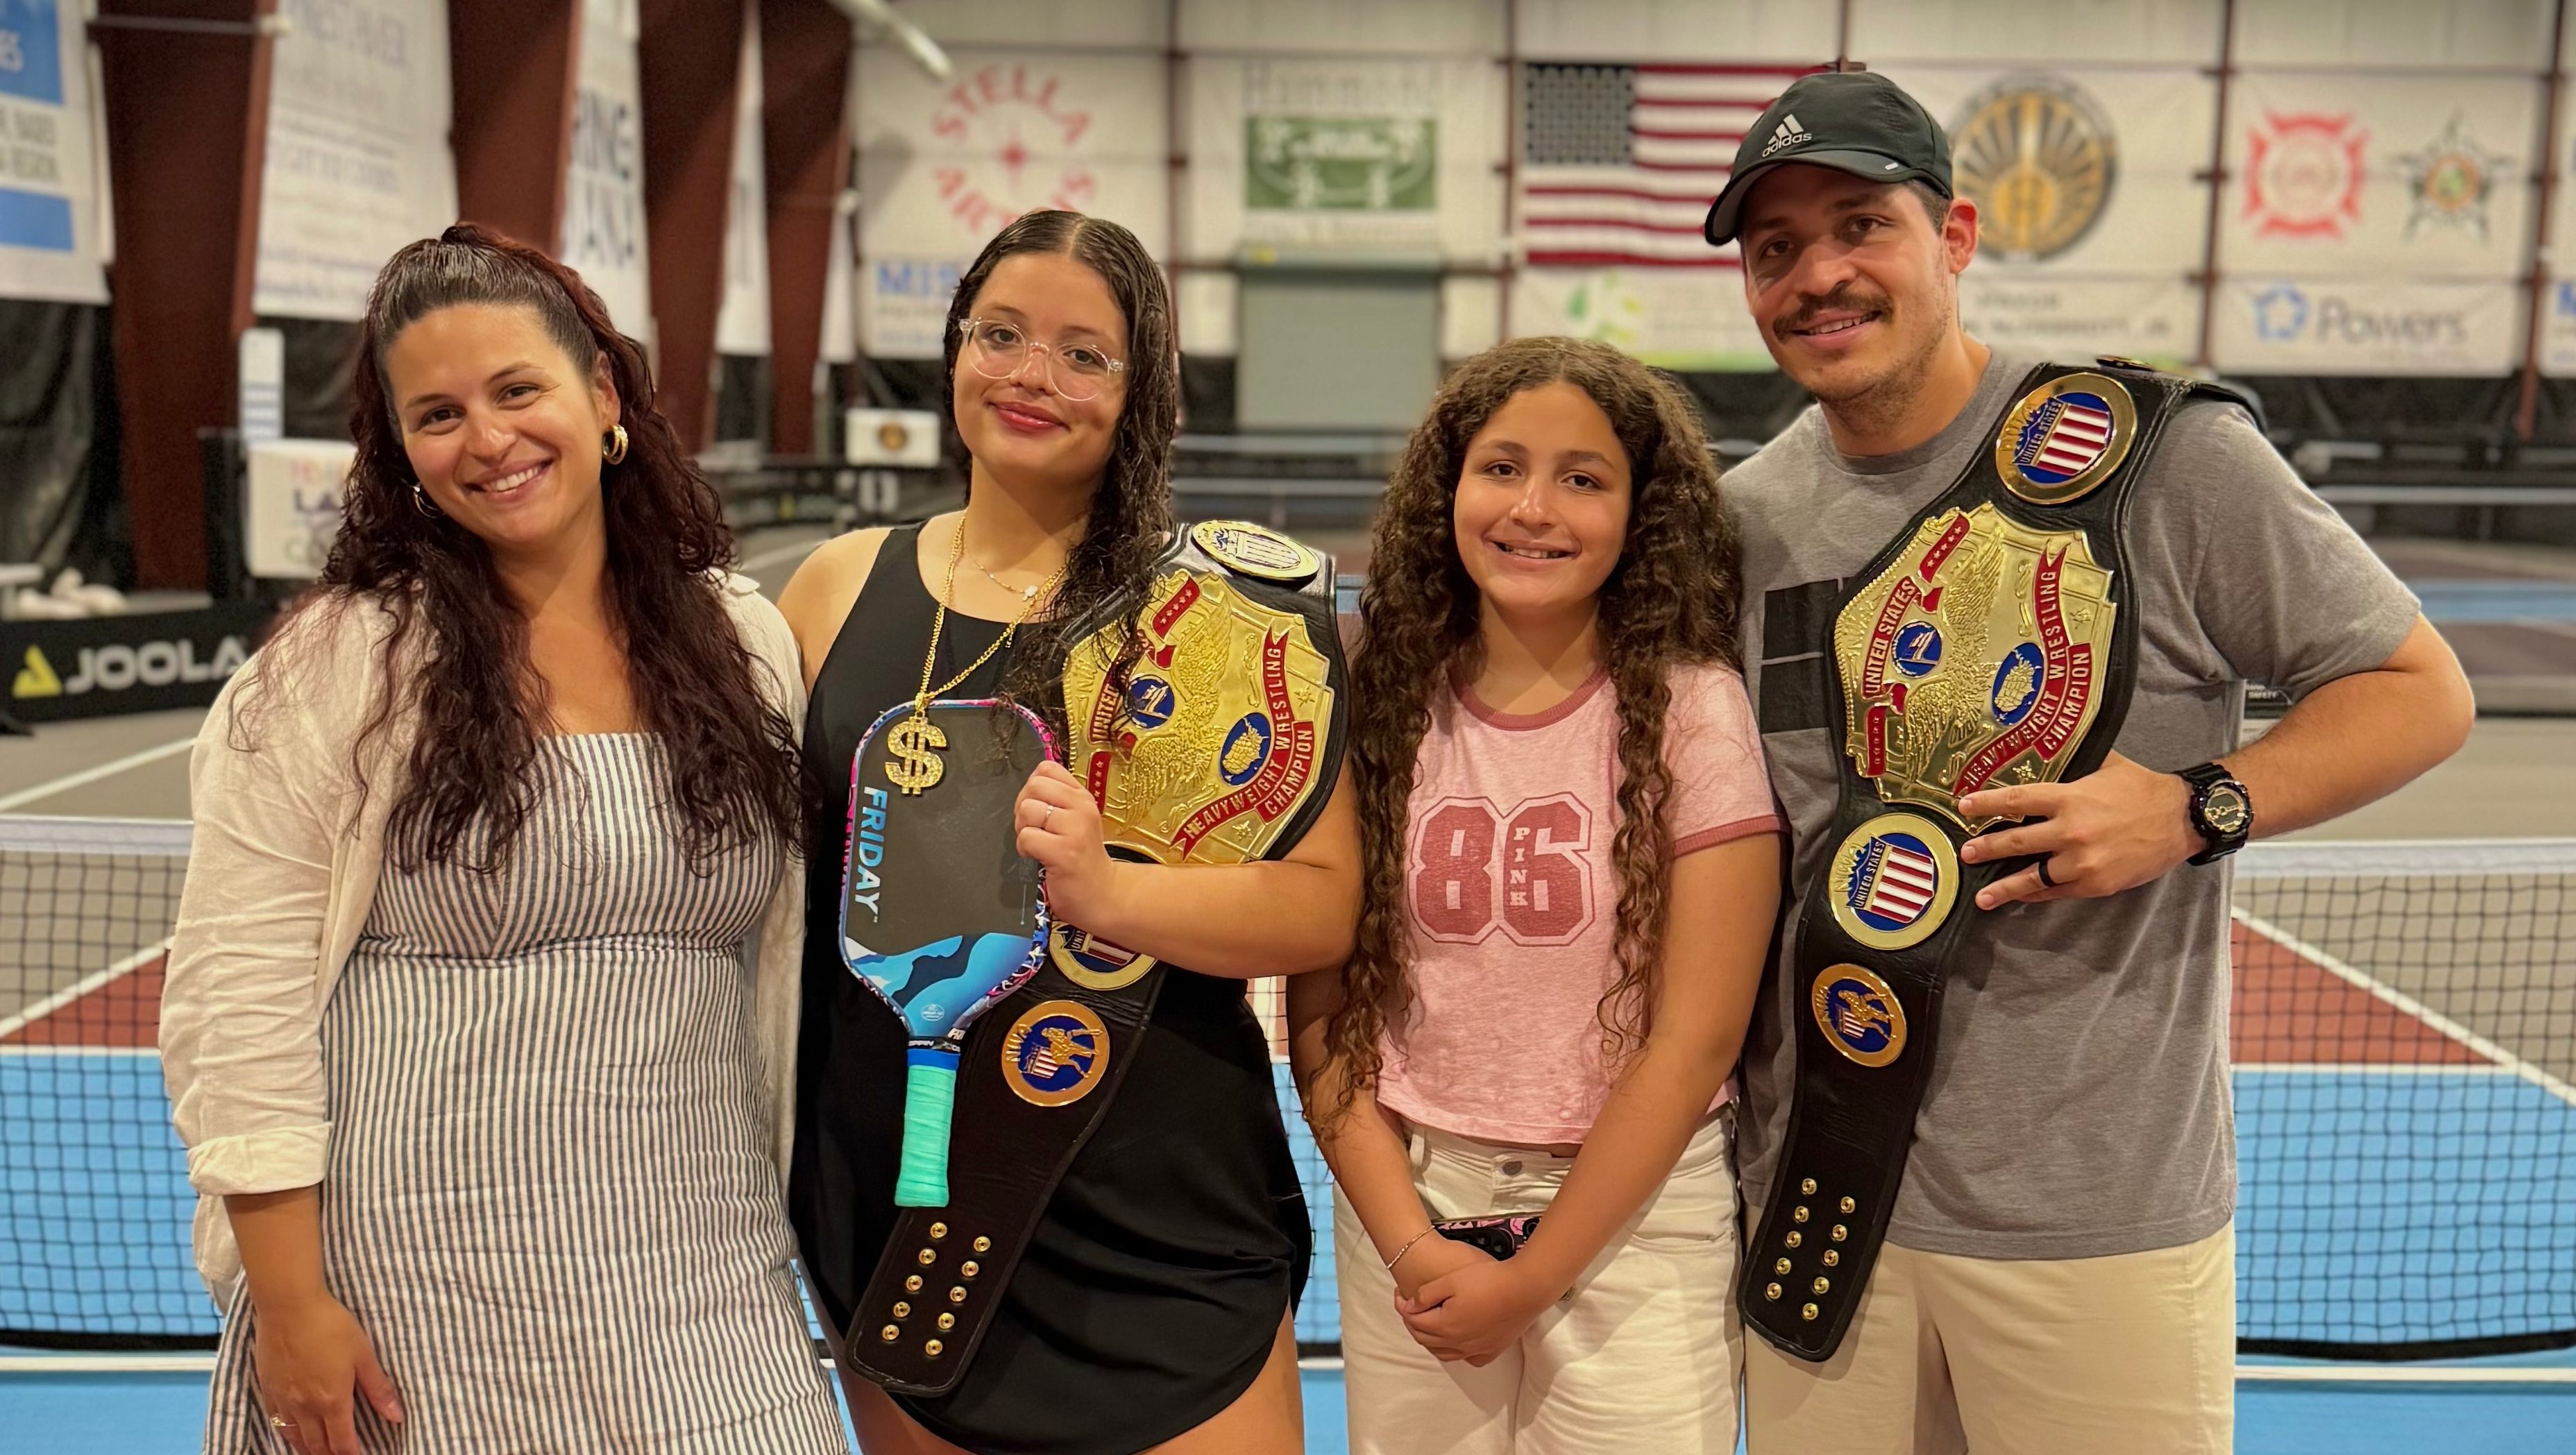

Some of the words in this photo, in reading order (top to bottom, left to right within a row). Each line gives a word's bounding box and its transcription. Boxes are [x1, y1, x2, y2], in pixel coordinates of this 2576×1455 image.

[931, 64, 1092, 145] STELLA
[1762, 132, 1812, 158] adidas
[2316, 295, 2469, 346] Powers
[2019, 432, 2044, 464] UNITED
[2038, 400, 2062, 432] STATES
[1877, 580, 1917, 636] STATES
[65, 636, 248, 693] JOOLA
[1865, 637, 1890, 694] UNITED
[1963, 690, 2060, 787] HEAVYWEIGHT
[2039, 570, 2067, 680] WRESTLING
[2042, 652, 2090, 751] CHAMPION
[1183, 758, 1284, 840] HEAVYWEIGHT
[1267, 646, 1291, 751] WRESTLING
[1266, 729, 1314, 815] CHAMPION
[854, 785, 888, 919] FRIDAY
[1408, 792, 1595, 946] 86
[1509, 826, 1531, 906] PINK
[1854, 875, 1873, 909] UNITED
[1867, 840, 1886, 874] STATES
